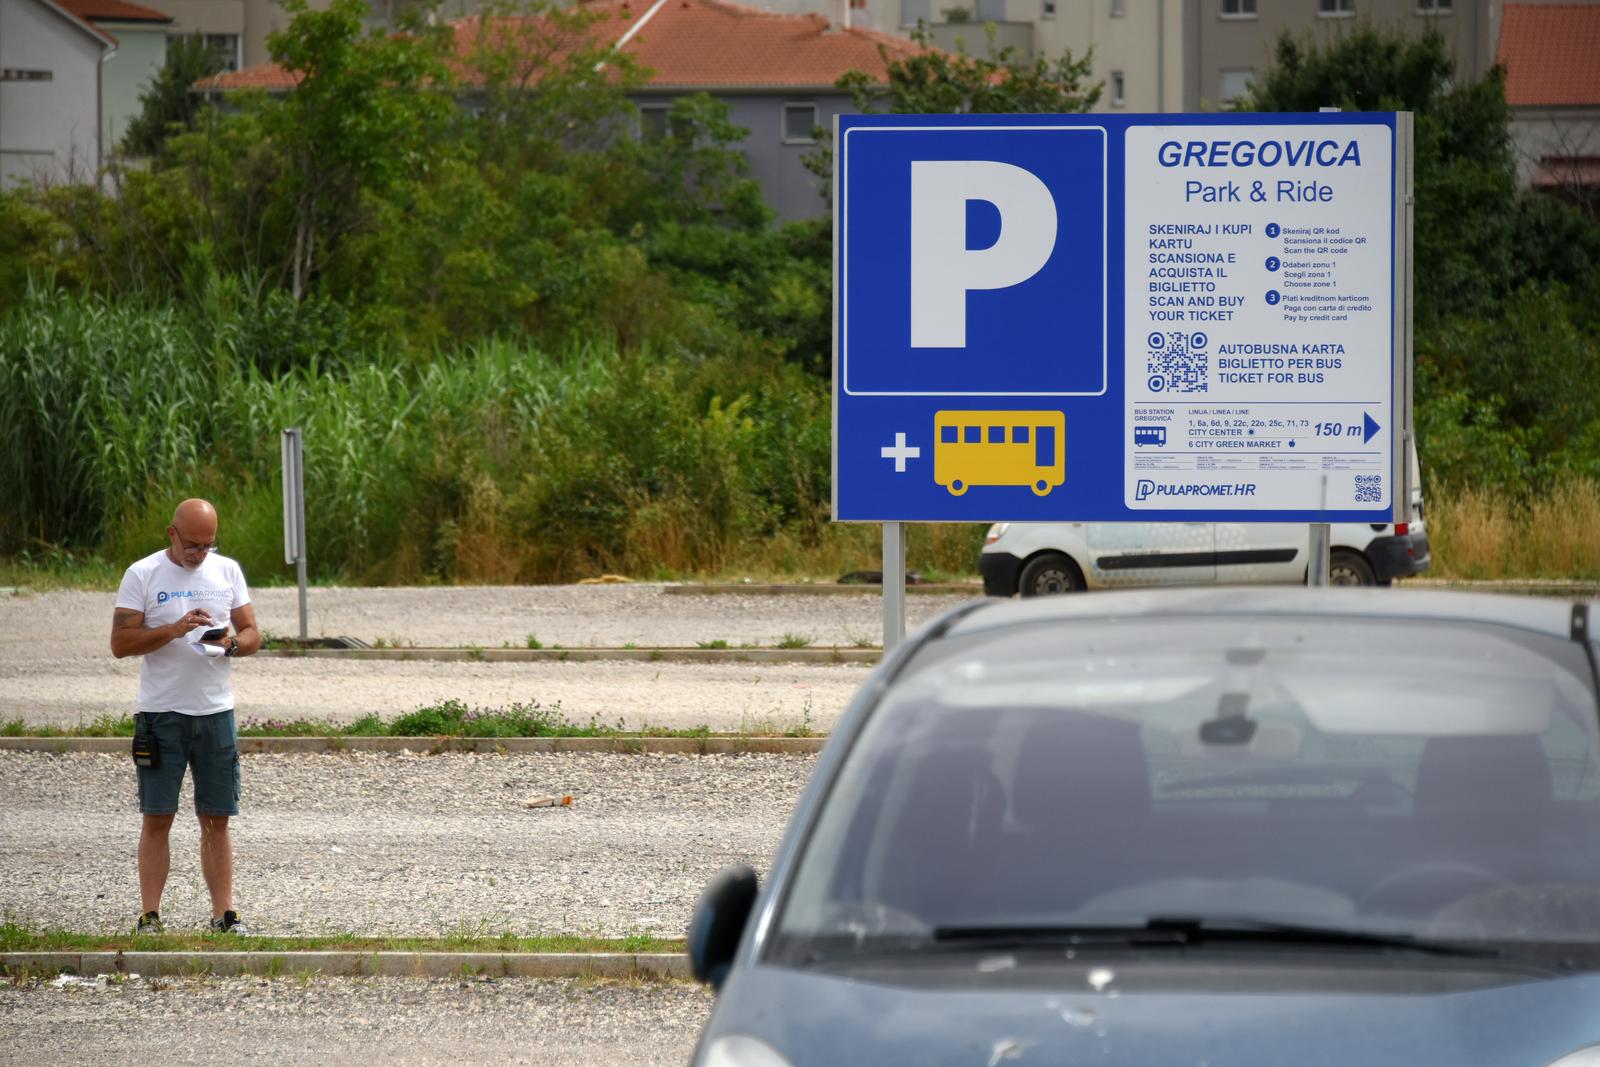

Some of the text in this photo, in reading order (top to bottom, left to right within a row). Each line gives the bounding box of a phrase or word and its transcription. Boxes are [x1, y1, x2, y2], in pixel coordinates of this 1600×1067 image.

[1158, 141, 1361, 167] GREGOVICA
[1186, 181, 1333, 202] Park & Ride
[1149, 224, 1252, 235] SKENIRAJ I KUPI
[1149, 239, 1192, 249] KARTU
[911, 161, 1058, 348] P
[1149, 253, 1236, 263] SCANSIONA E
[1149, 268, 1227, 279] ACQUISTA IL
[1149, 282, 1215, 292] BIGLIETTO
[1149, 296, 1245, 307] SCAN AND BUY
[1284, 305, 1301, 313] Paga
[1149, 310, 1234, 321] YOUR TICKET
[1219, 344, 1345, 355] AUTOBUSNA KARTA
[1219, 359, 1342, 369] BIGLIETTO PER BUS
[1219, 373, 1324, 383] TICKET FOR BUS
[1314, 423, 1361, 436] 150 m
[1157, 484, 1256, 496] PULAPROMET.HR
